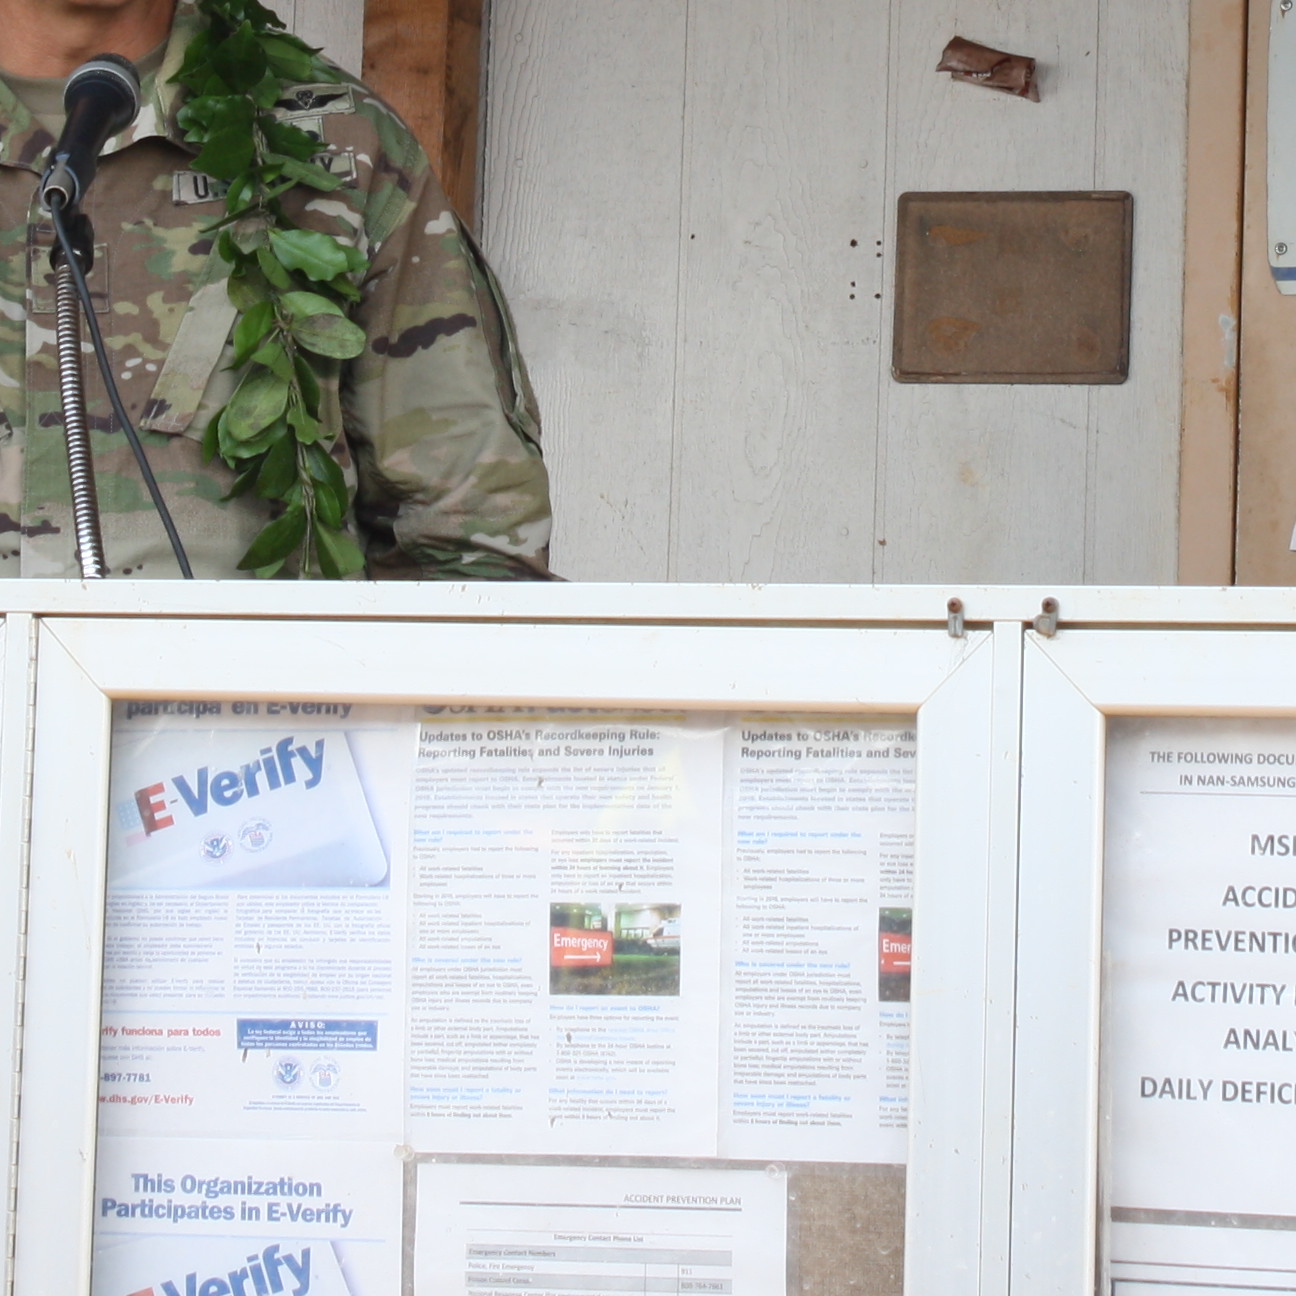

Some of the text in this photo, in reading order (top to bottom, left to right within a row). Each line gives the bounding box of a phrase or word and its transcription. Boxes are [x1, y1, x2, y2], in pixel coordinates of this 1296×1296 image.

[231, 700, 259, 715] en
[419, 728, 660, 743] Updates to OSHA's Recordkeeping Rule:
[417, 744, 654, 759] Reporting Fatalities and Severe Injuries
[1150, 750, 1173, 763] THE
[1176, 751, 1253, 765] FOLLOWING
[134, 736, 325, 838] E-Verify
[1178, 774, 1193, 786] IN
[1196, 774, 1296, 788] NAN-SAMSUNG
[553, 932, 609, 952] Emergency
[1171, 980, 1285, 1005] ACTIVITY
[120, 1026, 164, 1036] funciona
[166, 1028, 189, 1038] para
[191, 1027, 221, 1037] todos
[1139, 1076, 1212, 1101] DAILY
[132, 1172, 322, 1200] This Organization
[623, 1193, 742, 1205] ACCIDENT PREVENTION PLAN
[100, 1198, 354, 1228] Participates in E-Verify
